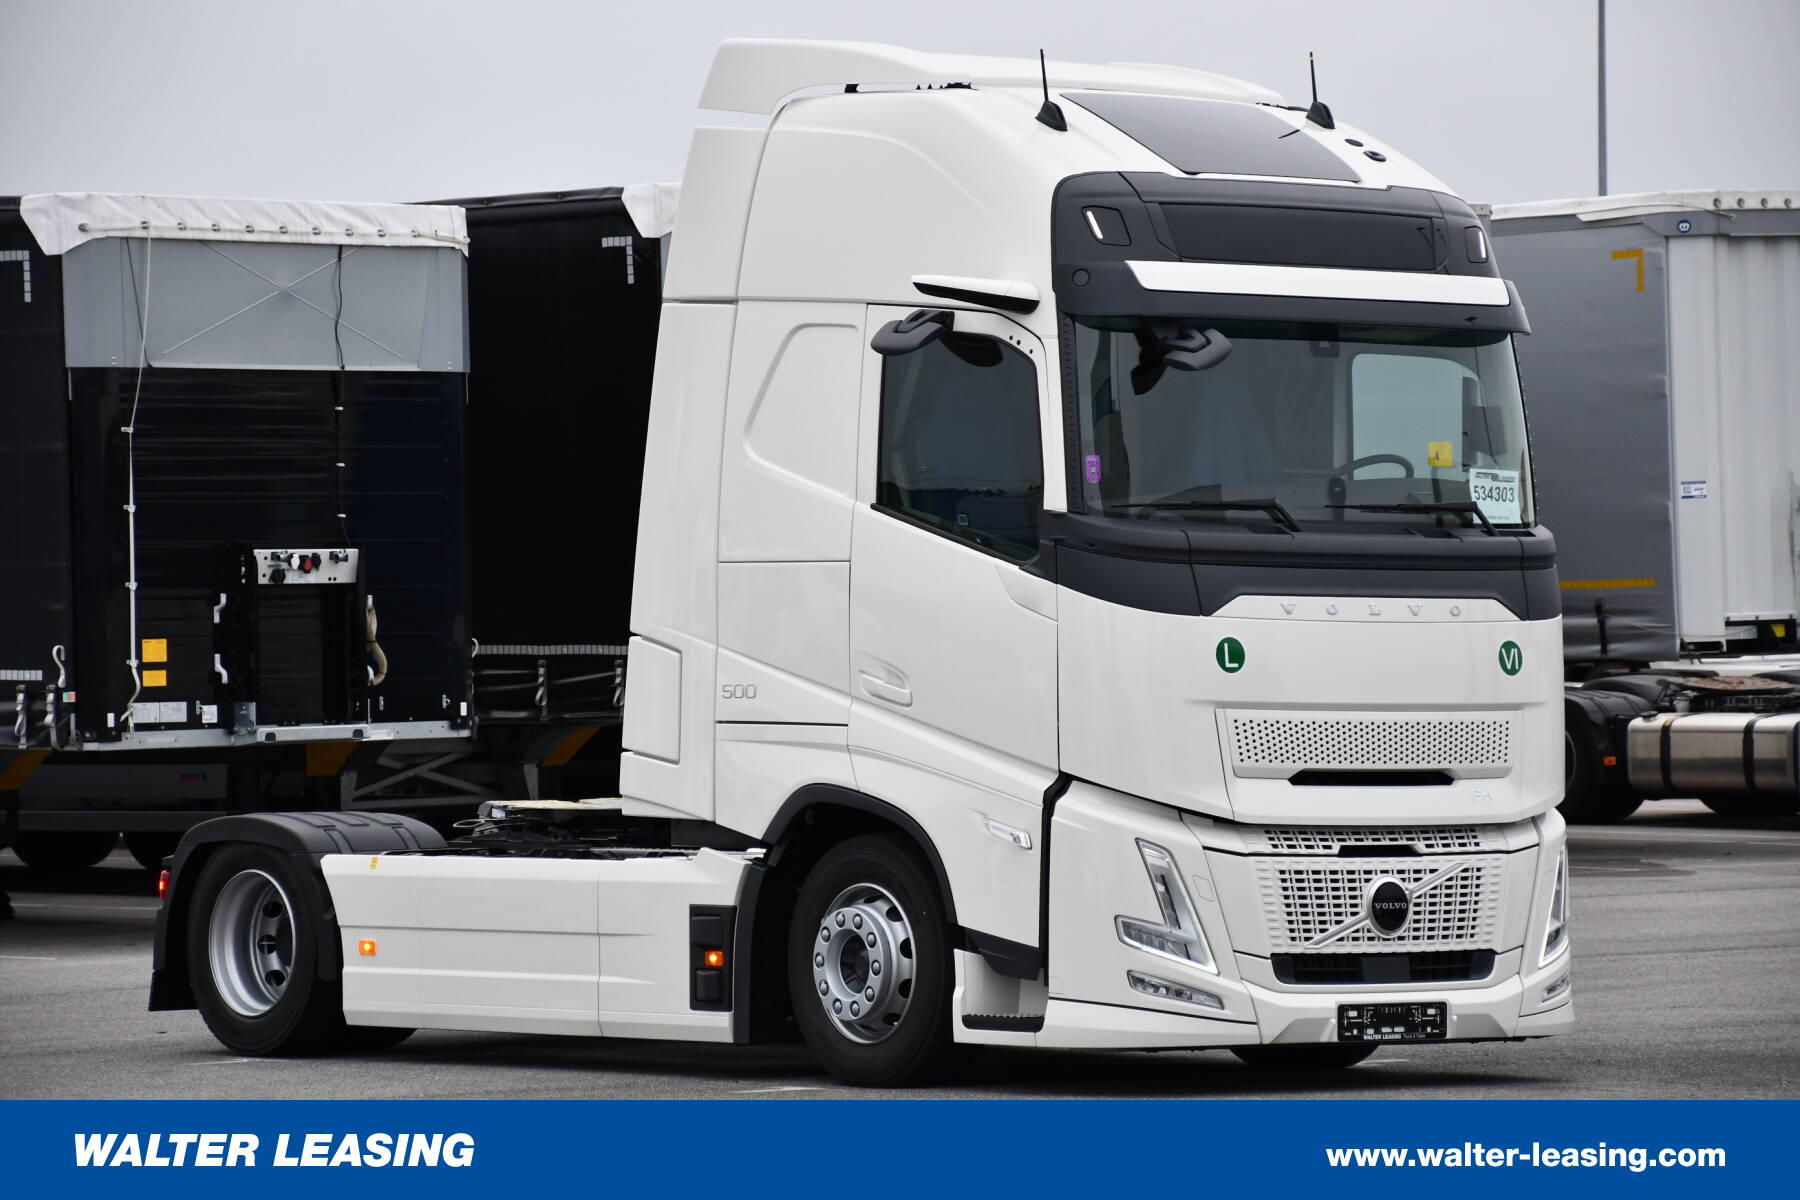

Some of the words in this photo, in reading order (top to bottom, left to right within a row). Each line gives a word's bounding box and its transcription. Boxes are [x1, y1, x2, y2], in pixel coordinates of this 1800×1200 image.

[1473, 484, 1515, 503] 534303
[1280, 602, 1462, 618] VOLVO
[1223, 642, 1239, 668] L
[1501, 647, 1519, 670] VI
[721, 684, 757, 699] 500
[1374, 902, 1407, 910] VOLVO
